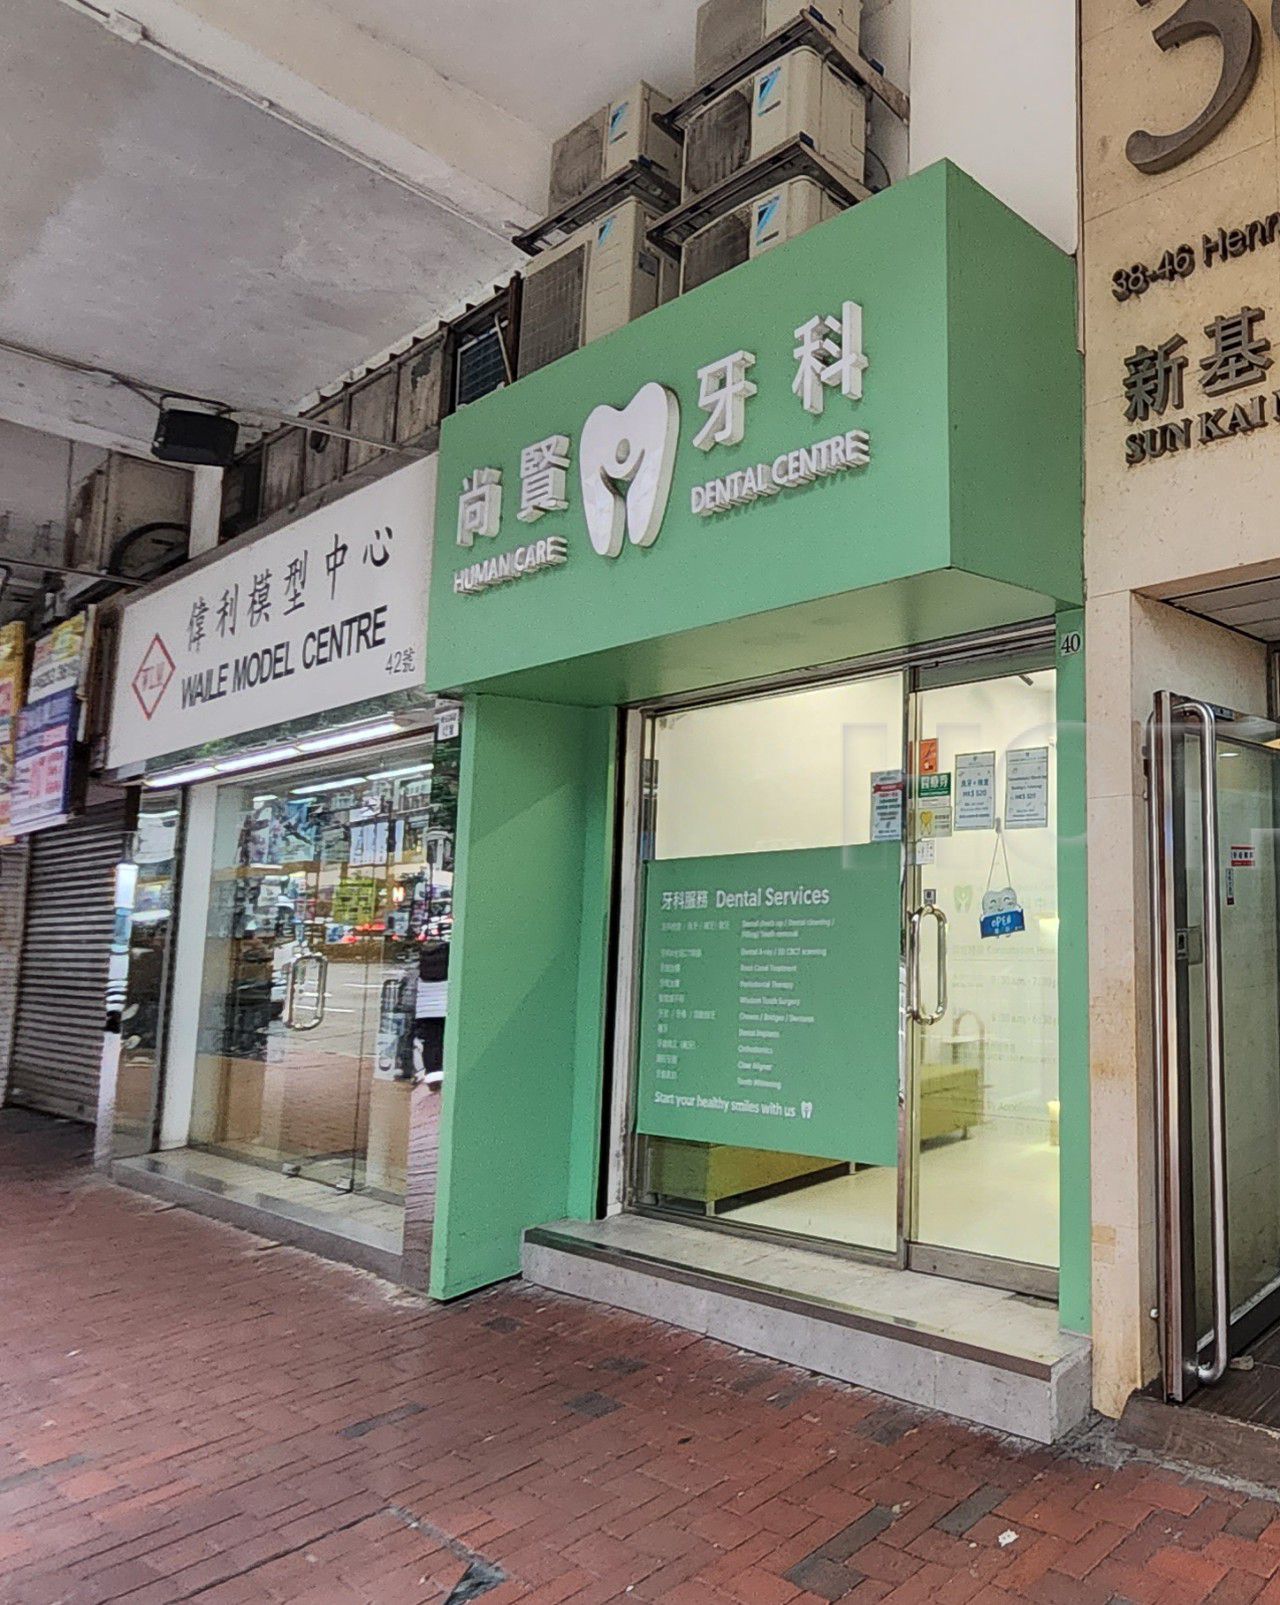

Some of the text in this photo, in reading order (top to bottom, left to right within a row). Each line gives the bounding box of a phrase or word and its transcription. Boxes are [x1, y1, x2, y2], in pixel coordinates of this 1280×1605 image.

[1112, 244, 1195, 301] 38-46
[693, 300, 869, 451] 牙科
[1125, 418, 1191, 466] SUN
[1199, 395, 1267, 445] KAI
[456, 434, 571, 547] 尚賢
[691, 429, 870, 517] DENTAL CENTRE
[187, 525, 393, 653] 偉利模型中心
[453, 536, 569, 595] HUMAN CARE
[231, 640, 295, 693] MODEL
[302, 604, 388, 671] CENTRE
[1061, 633, 1081, 653] 40
[715, 886, 830, 909] Dental Services
[654, 1091, 796, 1118] Start your healthy smiles with us
